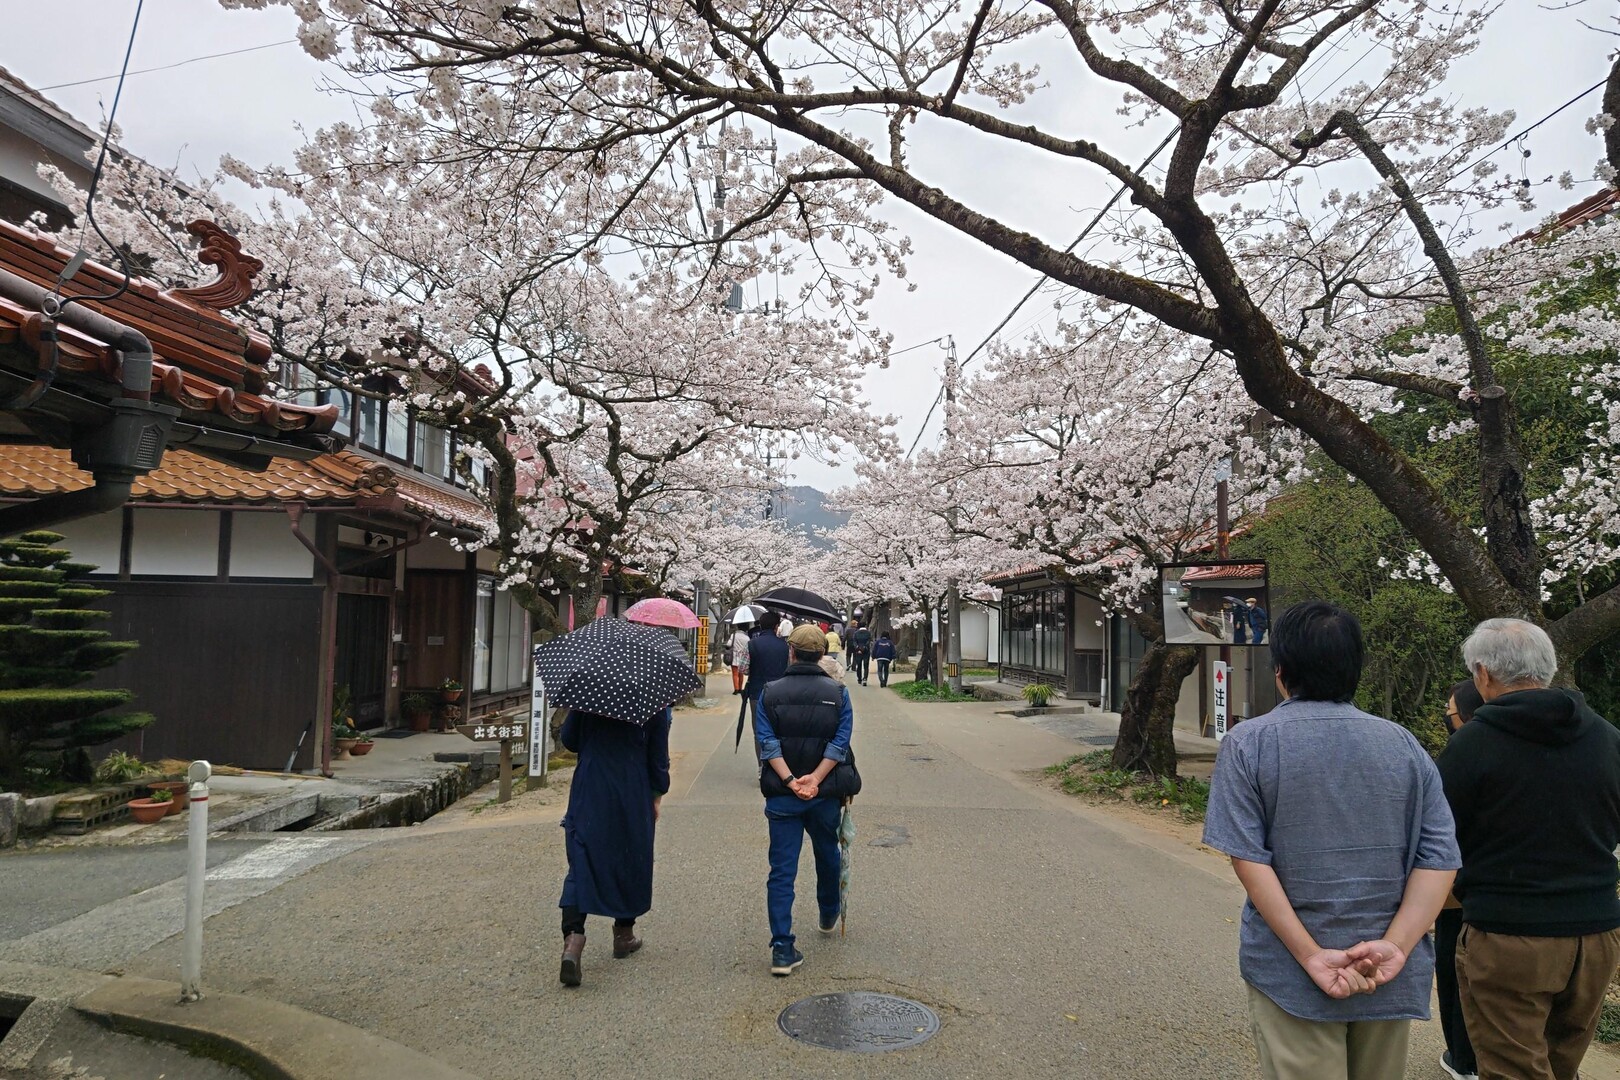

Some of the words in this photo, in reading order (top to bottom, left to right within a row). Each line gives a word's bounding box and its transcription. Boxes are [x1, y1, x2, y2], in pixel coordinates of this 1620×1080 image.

[1215, 688, 1225, 733] 注意
[474, 725, 524, 739] 出雲街道
